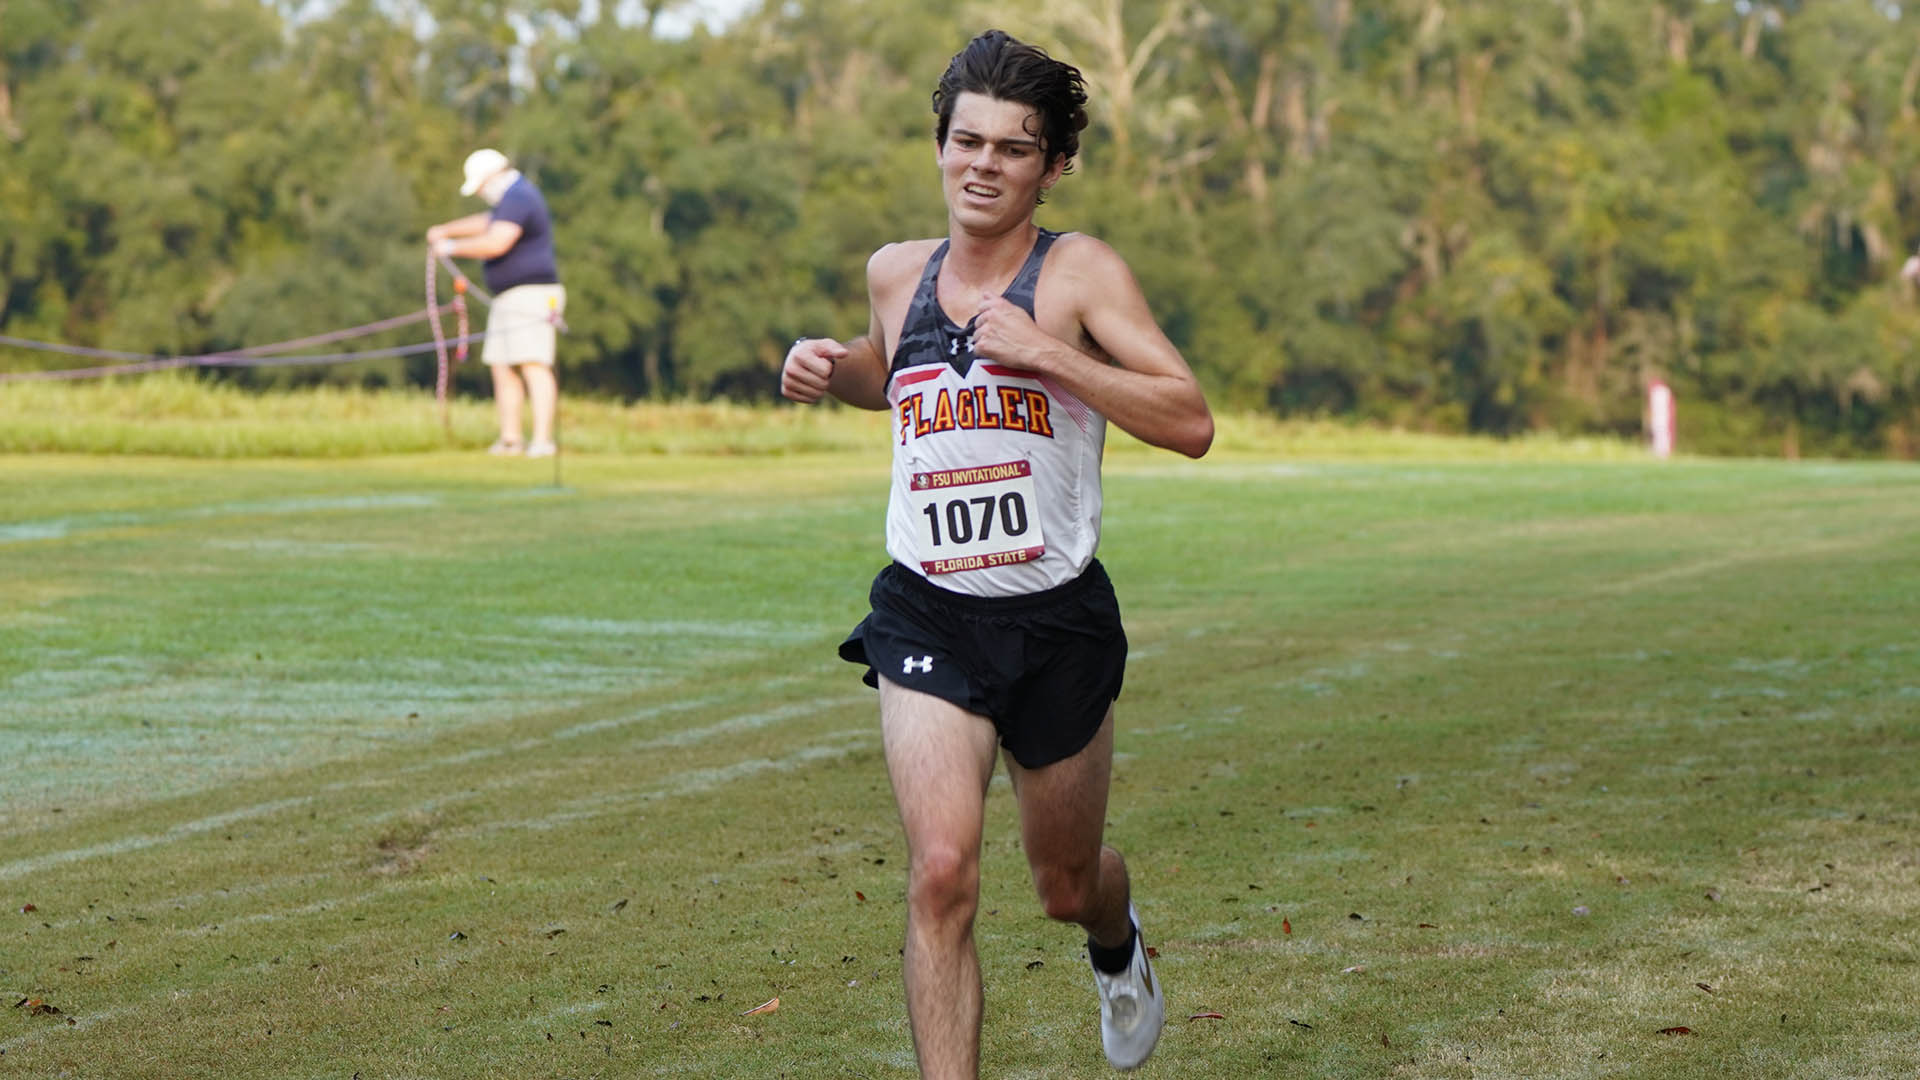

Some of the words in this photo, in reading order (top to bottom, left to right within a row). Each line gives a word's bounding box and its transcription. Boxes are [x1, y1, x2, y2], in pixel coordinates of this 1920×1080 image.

[898, 385, 1055, 446] FLAGLER
[932, 471, 950, 487] FSU
[952, 463, 1022, 485] INVITATIONAL
[923, 491, 1029, 547] 1070
[935, 557, 984, 573] FLORIDA
[989, 550, 1027, 566] STATE
